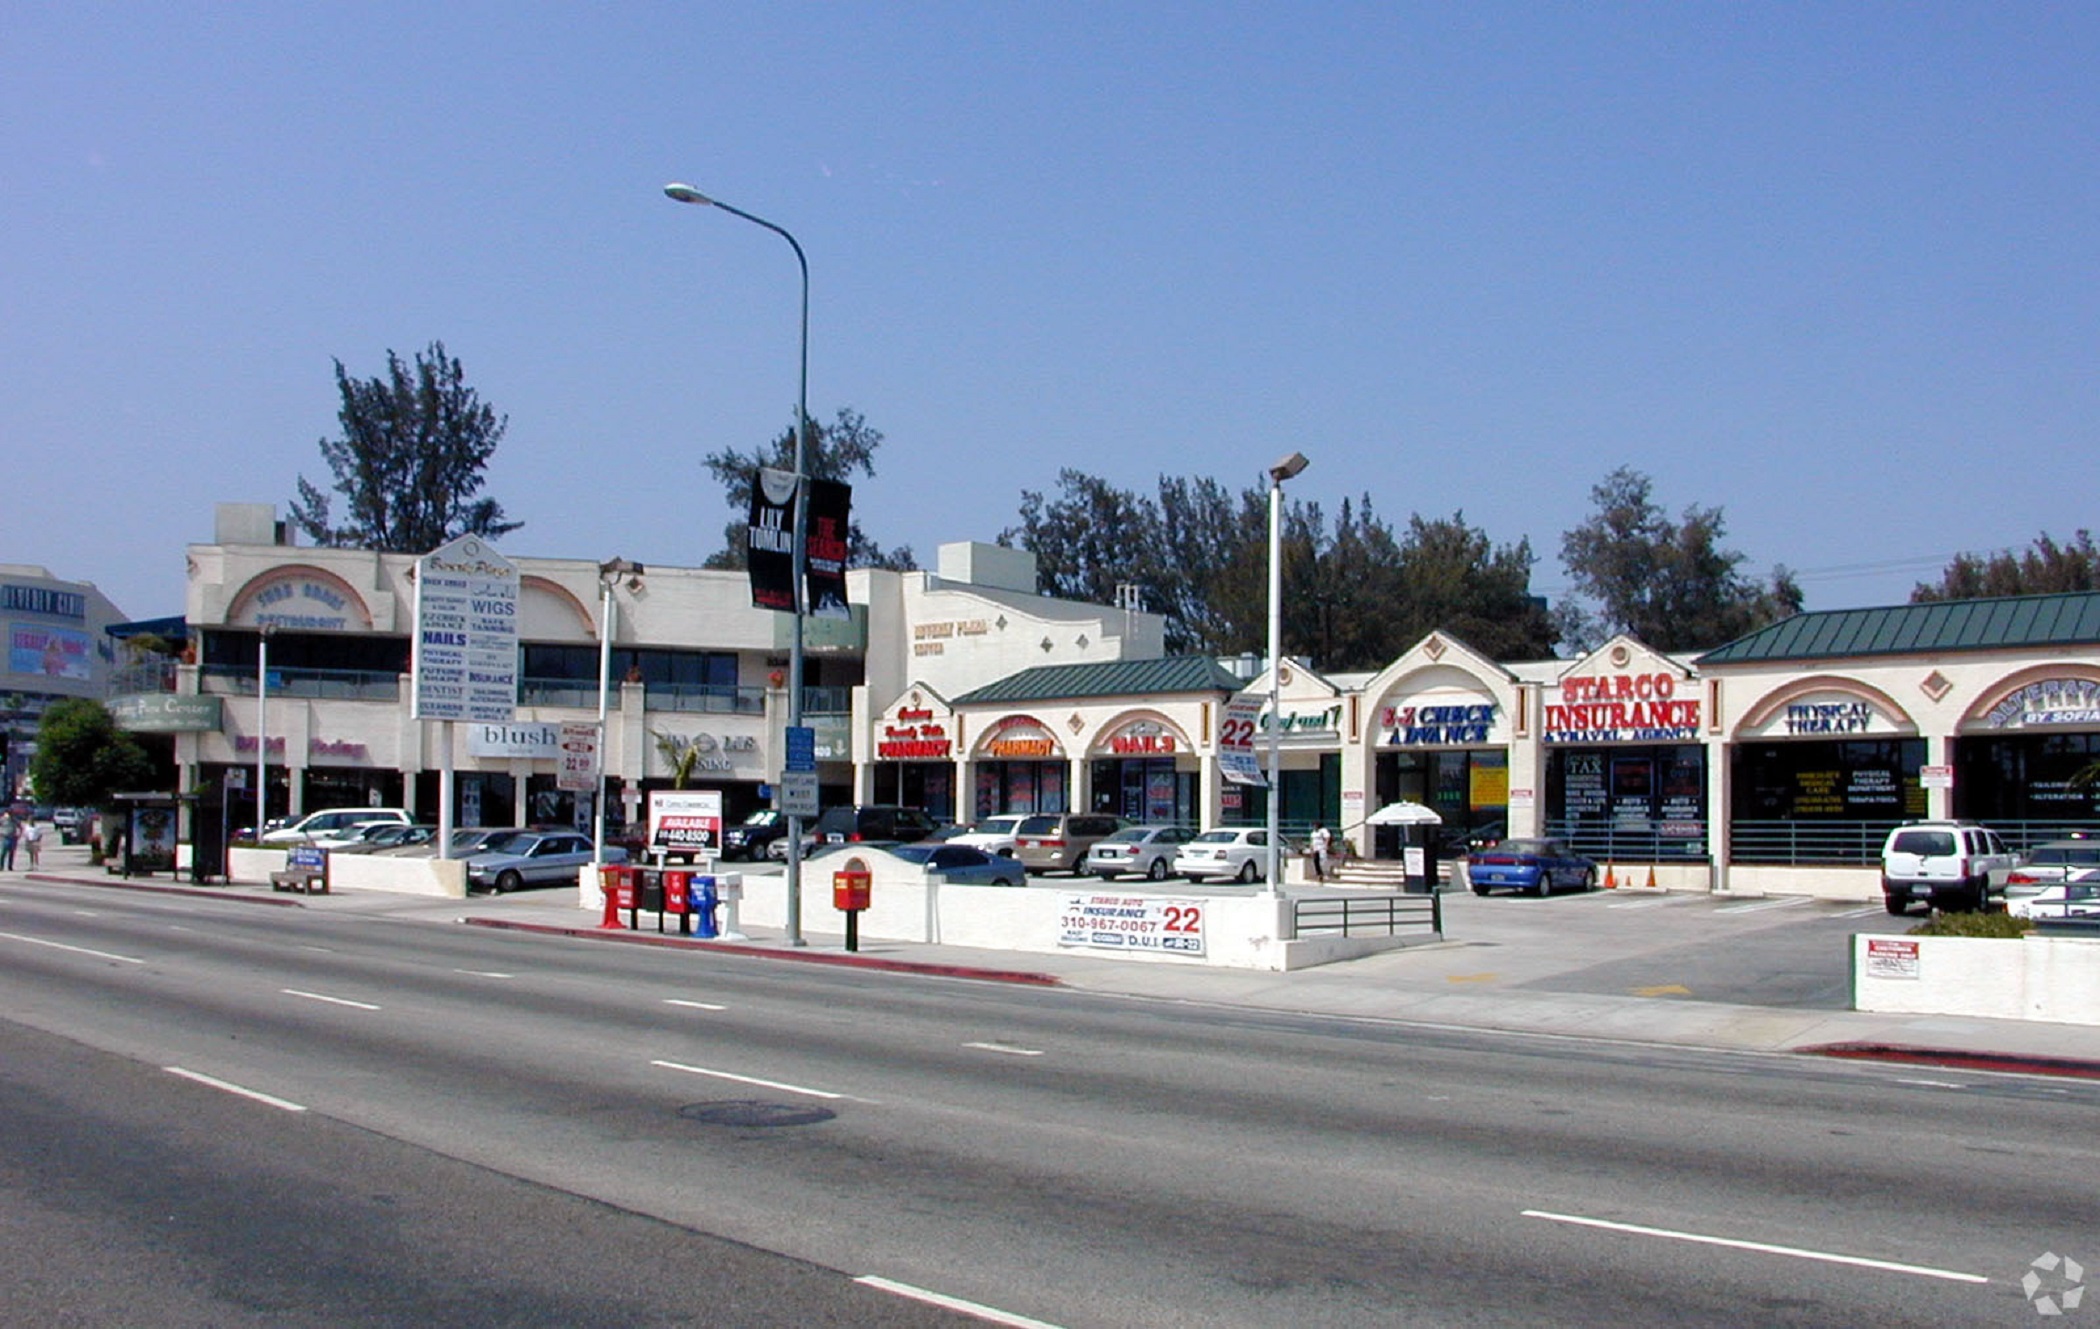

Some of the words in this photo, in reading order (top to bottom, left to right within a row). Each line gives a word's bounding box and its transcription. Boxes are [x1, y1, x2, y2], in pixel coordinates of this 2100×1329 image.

[760, 506, 785, 530] LILY
[748, 526, 792, 555] TOMLIN
[472, 600, 516, 616] WIGS
[422, 631, 467, 646] NAILS
[1561, 673, 1676, 703] STARCO
[1419, 704, 1497, 724] CHECK
[1545, 700, 1700, 732] INSURANCE
[1787, 703, 1870, 719] PHYSICAL
[2025, 712, 2051, 724] BY
[2052, 711, 2100, 722] SOFIA
[1220, 719, 1255, 747] 22
[1785, 717, 1870, 733] THERAPY
[485, 726, 557, 745] blush
[1389, 723, 1489, 745] ADVANCE
[1559, 729, 1623, 742] TRAVEL
[1634, 727, 1699, 741] AGENCY
[878, 740, 952, 757] PHARMACY
[990, 739, 1054, 757] PHARMACY
[1111, 735, 1176, 754] NAILS
[1569, 760, 1602, 774] TAX
[1854, 777, 1891, 786] THERAPY
[664, 817, 711, 828] AVAILABLE
[1083, 907, 1147, 918] INSURANCE
[1163, 906, 1201, 933] 22
[1061, 916, 1157, 933] 310-967-0067
